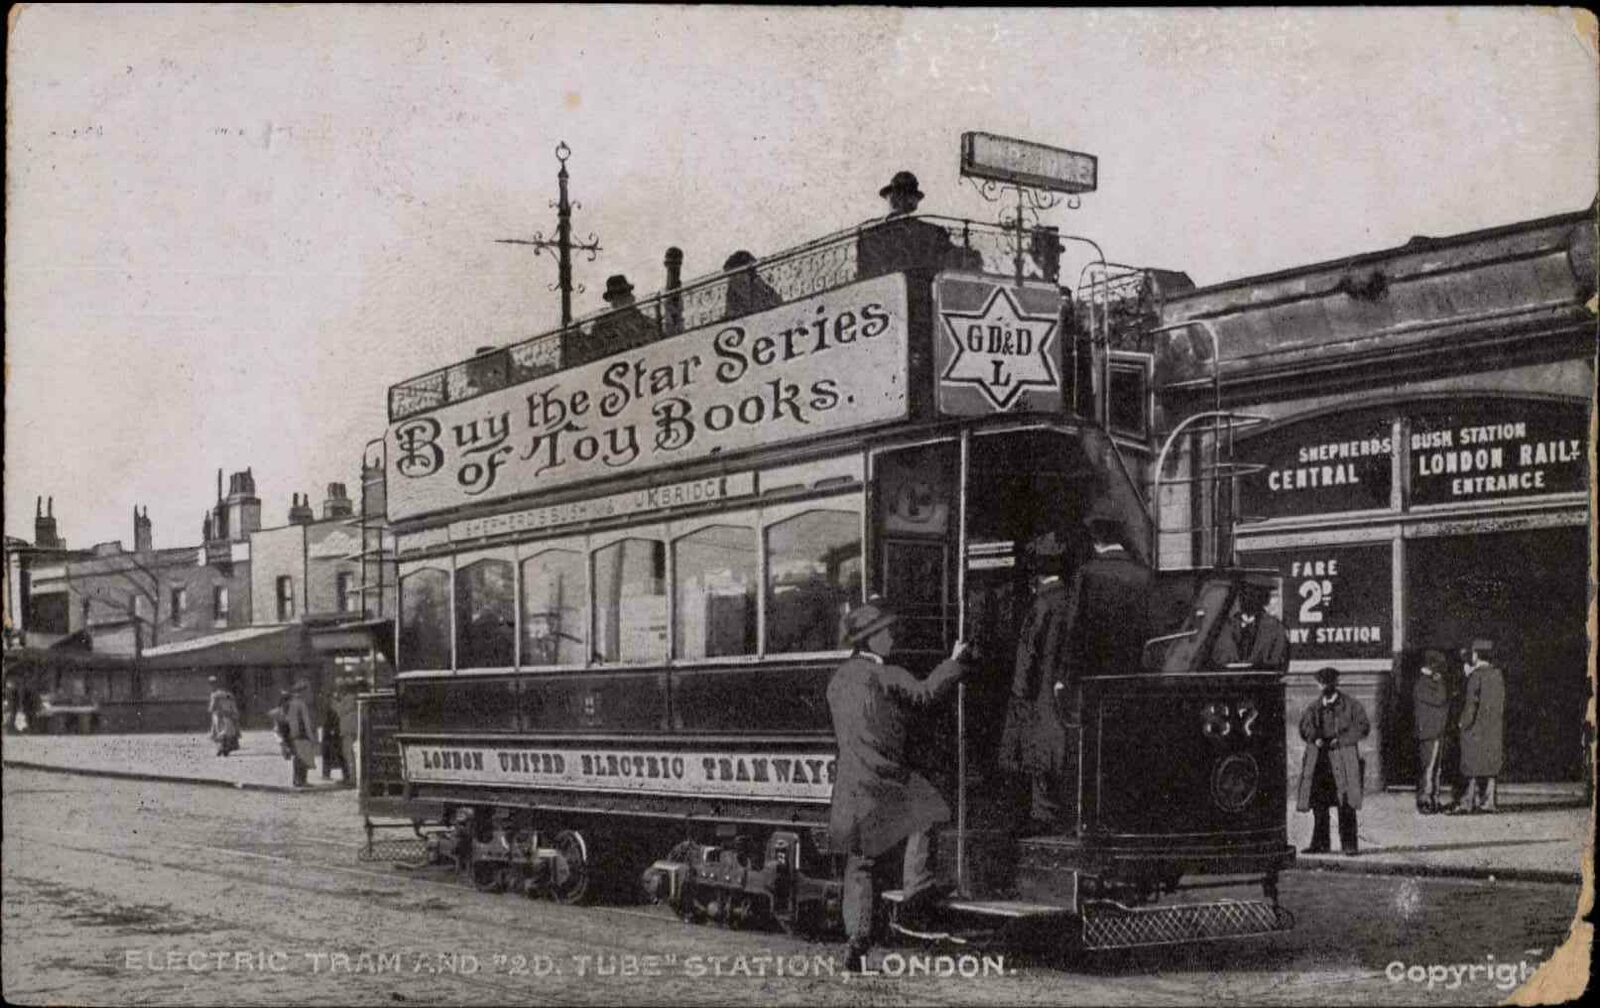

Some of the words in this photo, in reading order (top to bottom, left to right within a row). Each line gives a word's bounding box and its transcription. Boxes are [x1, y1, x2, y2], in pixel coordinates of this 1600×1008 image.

[990, 360, 1012, 387] L
[396, 411, 509, 478] Buy
[526, 386, 591, 430] the
[600, 353, 702, 416] Star
[713, 302, 890, 384] Series
[457, 443, 515, 495] of
[520, 421, 639, 477] Toy
[651, 377, 855, 453] Books.
[1299, 438, 1392, 462] SHEPHERDS
[1411, 430, 1452, 451] BUSH
[1460, 422, 1526, 446] STATION
[1268, 463, 1359, 490] CENTRAL
[1419, 447, 1503, 476] LONDON
[1452, 471, 1546, 495] ENTRANCE
[1292, 560, 1338, 577] FARE
[1286, 629, 1309, 643] NY
[1316, 626, 1381, 643] STATION
[422, 750, 484, 771] LONDON
[498, 752, 566, 774] UNITED
[581, 754, 685, 780] ELECTRIC
